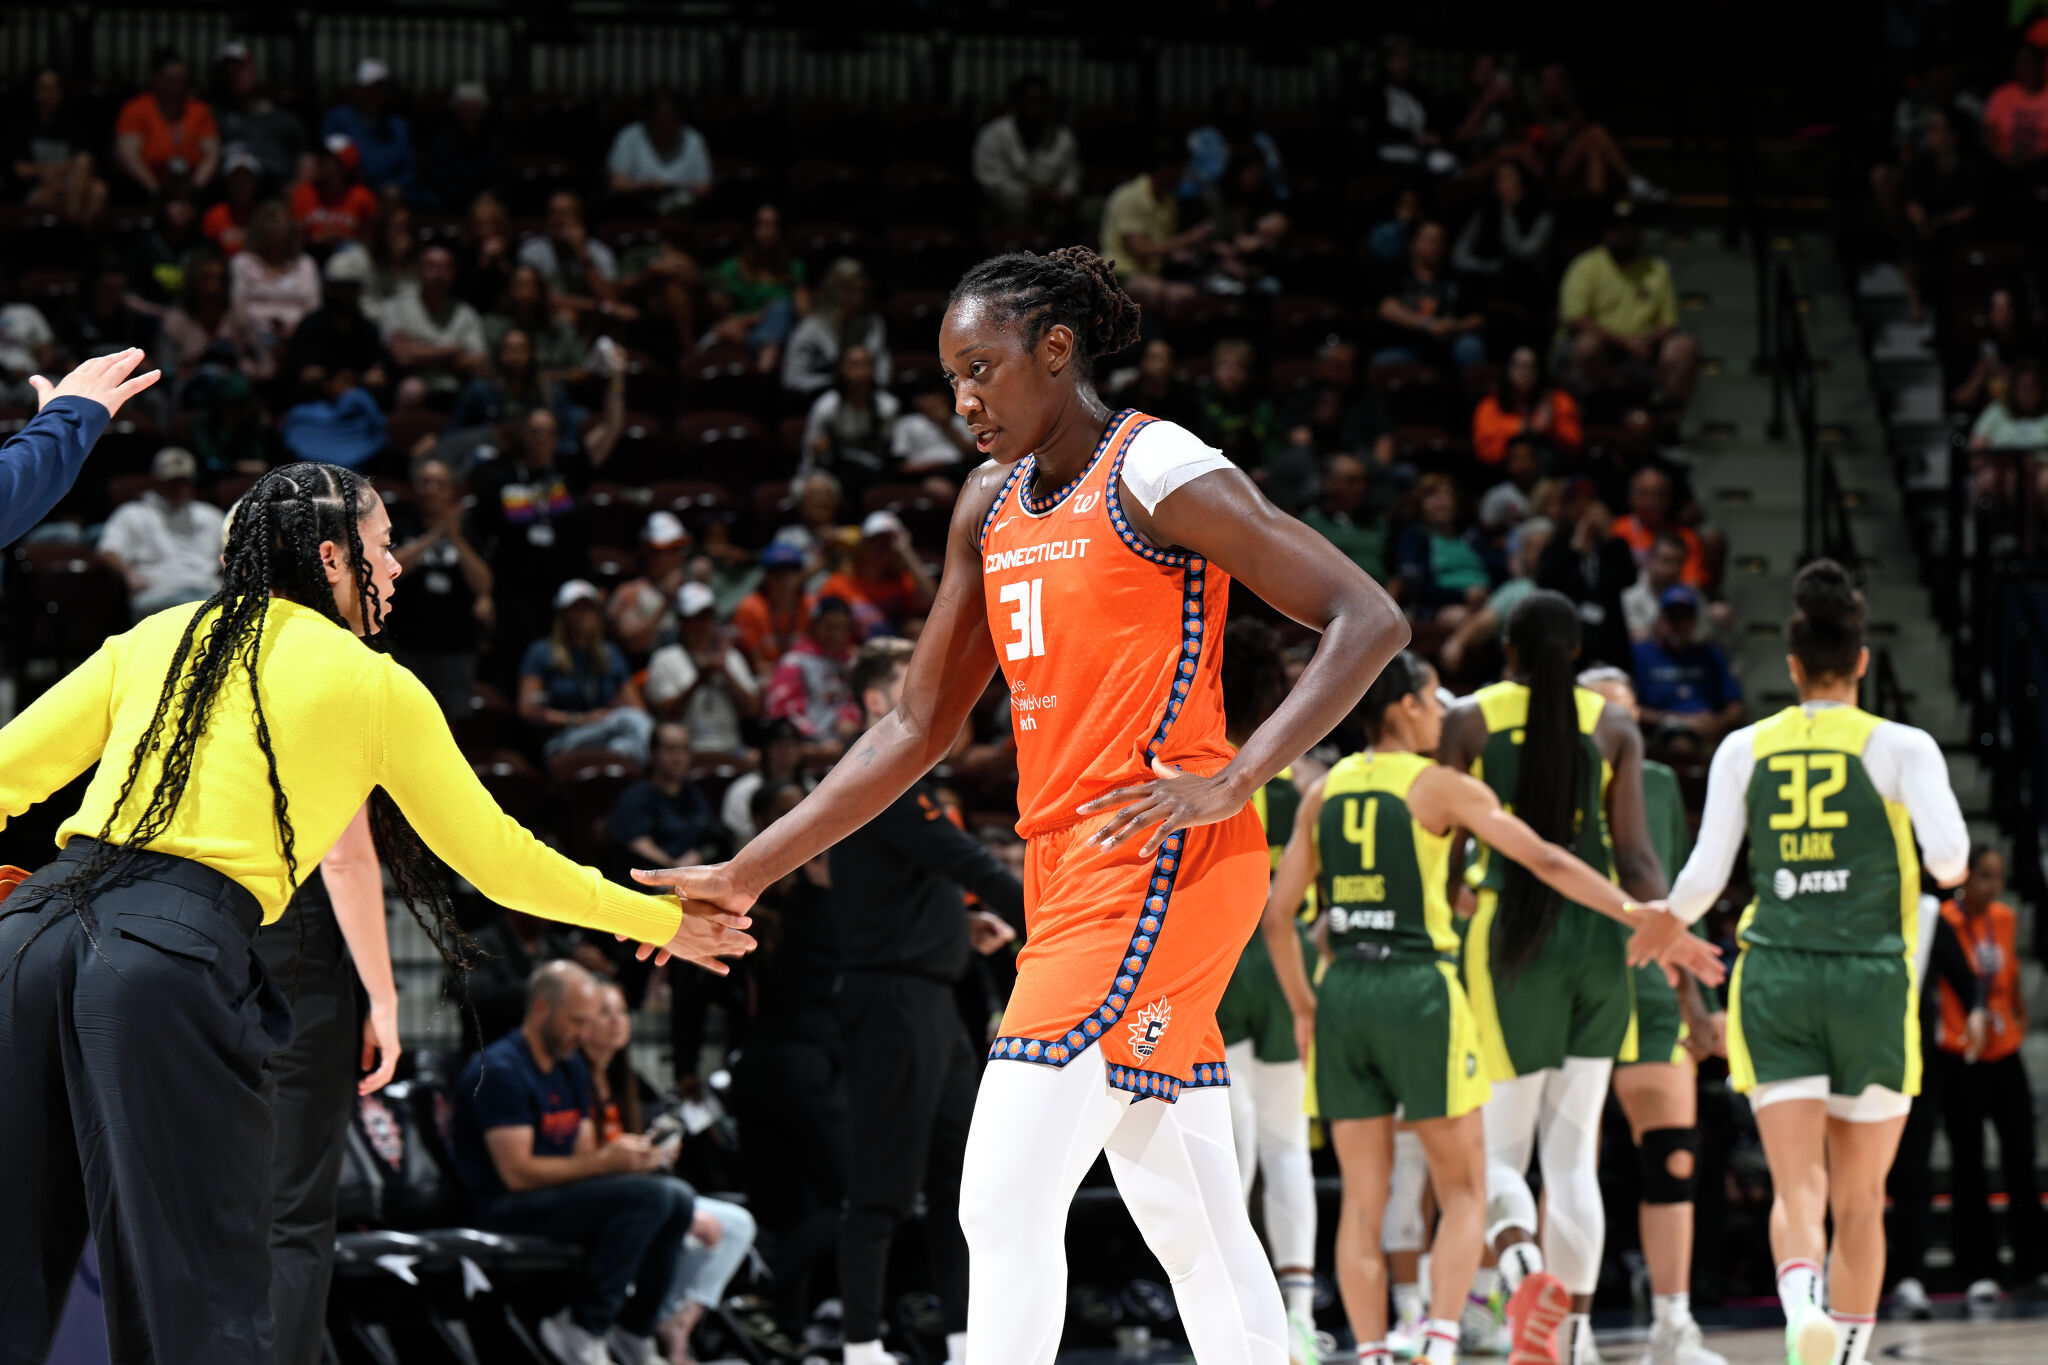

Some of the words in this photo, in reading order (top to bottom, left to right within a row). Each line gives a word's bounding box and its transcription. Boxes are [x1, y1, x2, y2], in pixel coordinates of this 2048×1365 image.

[985, 538, 1091, 574] CONNECTICUT
[1000, 578, 1045, 661] 31
[1768, 754, 1848, 829] 32
[1343, 798, 1378, 869] 4
[1779, 832, 1835, 862] CLARK
[1798, 869, 1851, 894] AT&T
[1348, 910, 1396, 930] AT&T
